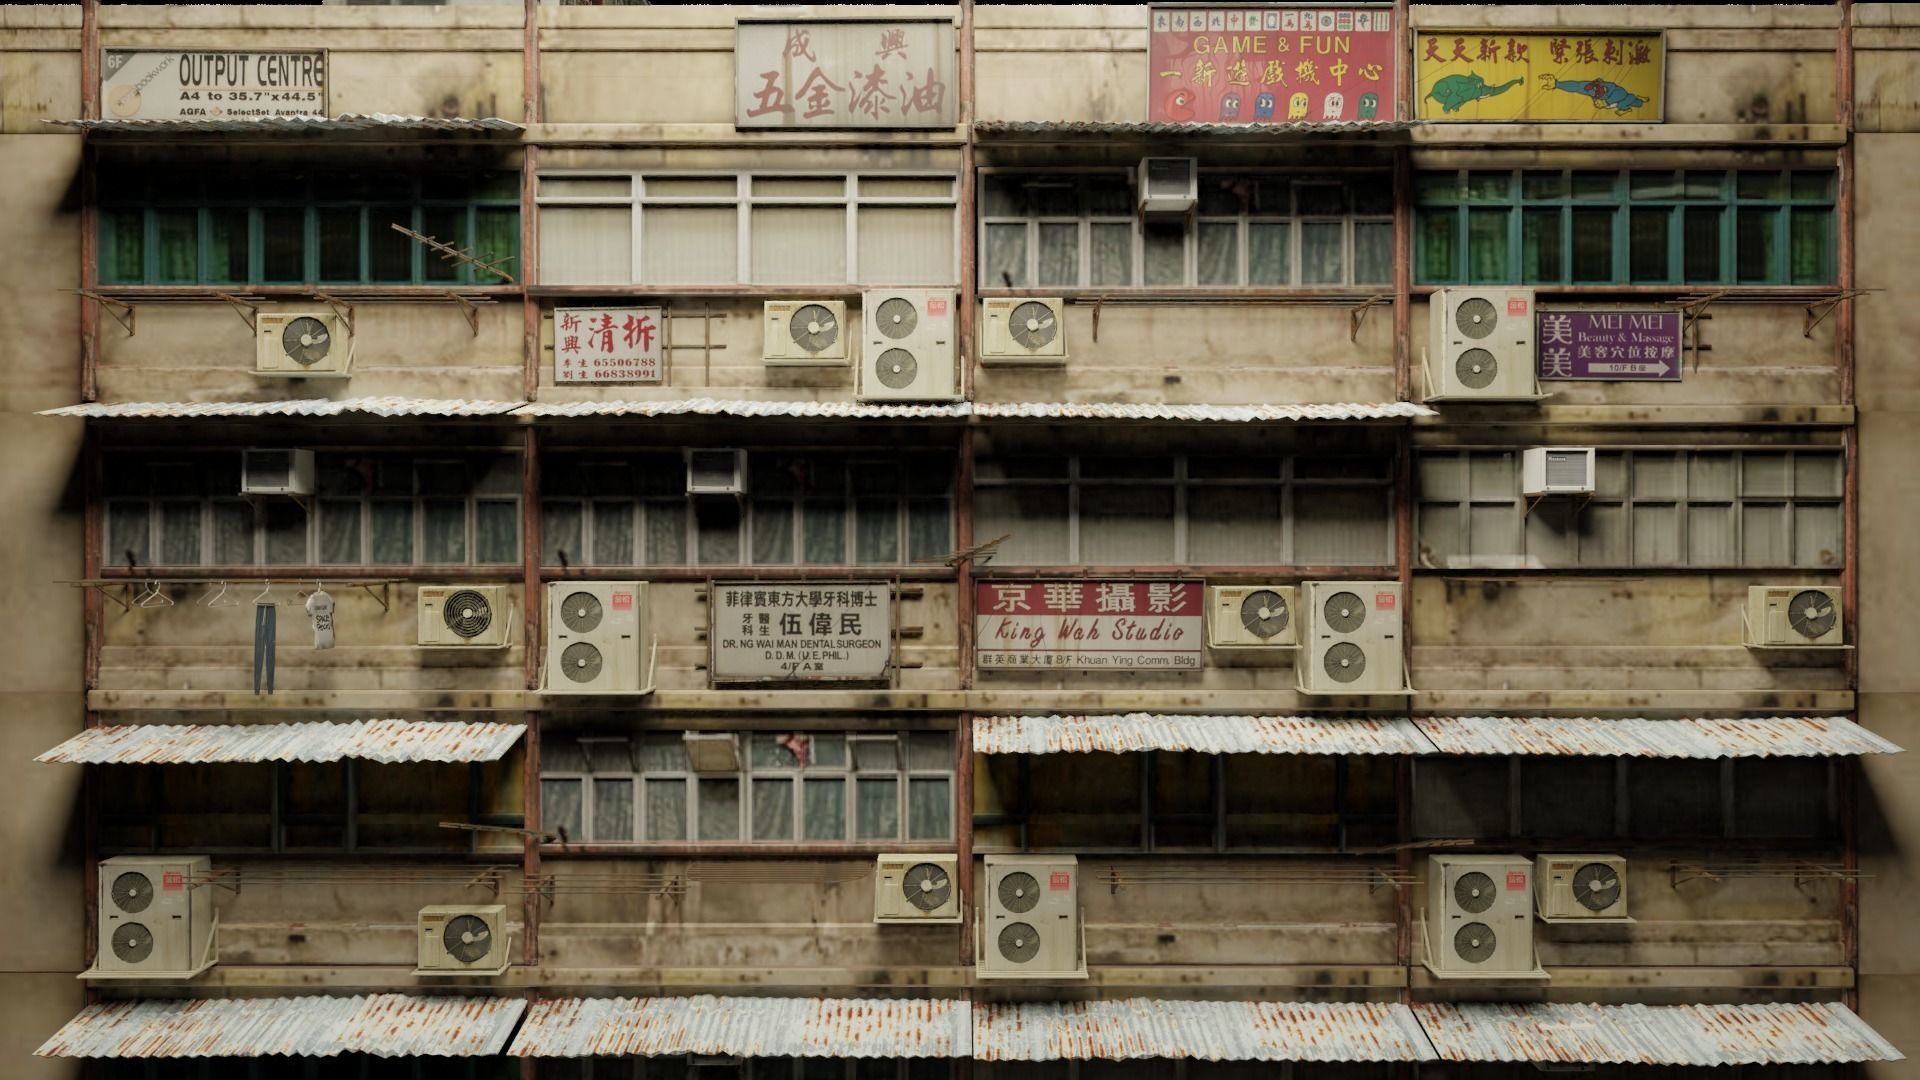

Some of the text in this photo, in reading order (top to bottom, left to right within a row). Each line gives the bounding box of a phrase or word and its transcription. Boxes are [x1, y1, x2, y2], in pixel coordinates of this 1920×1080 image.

[1193, 36, 1350, 54] GAME & FUN
[1423, 38, 1530, 64] 天天新款
[108, 55, 123, 69] 6F
[180, 54, 324, 87] OUTPUT CENTRE
[180, 92, 200, 100] A4
[208, 92, 223, 100] to
[746, 64, 946, 120] 五金漆油
[1589, 315, 1663, 329] MEI MEI
[560, 313, 582, 354] 新興
[588, 313, 656, 353] 清拆
[1578, 332, 1674, 344] Beauty & Massage
[1542, 315, 1573, 377] 美美
[594, 359, 656, 367] 65506788
[595, 370, 656, 378] 66838991
[726, 591, 877, 607] 菲律賓東方大學牙科博士
[991, 582, 1186, 613] 京華攝影
[779, 612, 862, 636] 伍偉民
[995, 618, 1183, 648] King Wah Studio
[723, 640, 881, 649] DR. NG WAI MAN DENTAL SURGEON
[1077, 655, 1107, 665] Khuan
[1112, 655, 1133, 666] Ying
[1174, 655, 1196, 666] Bldg
